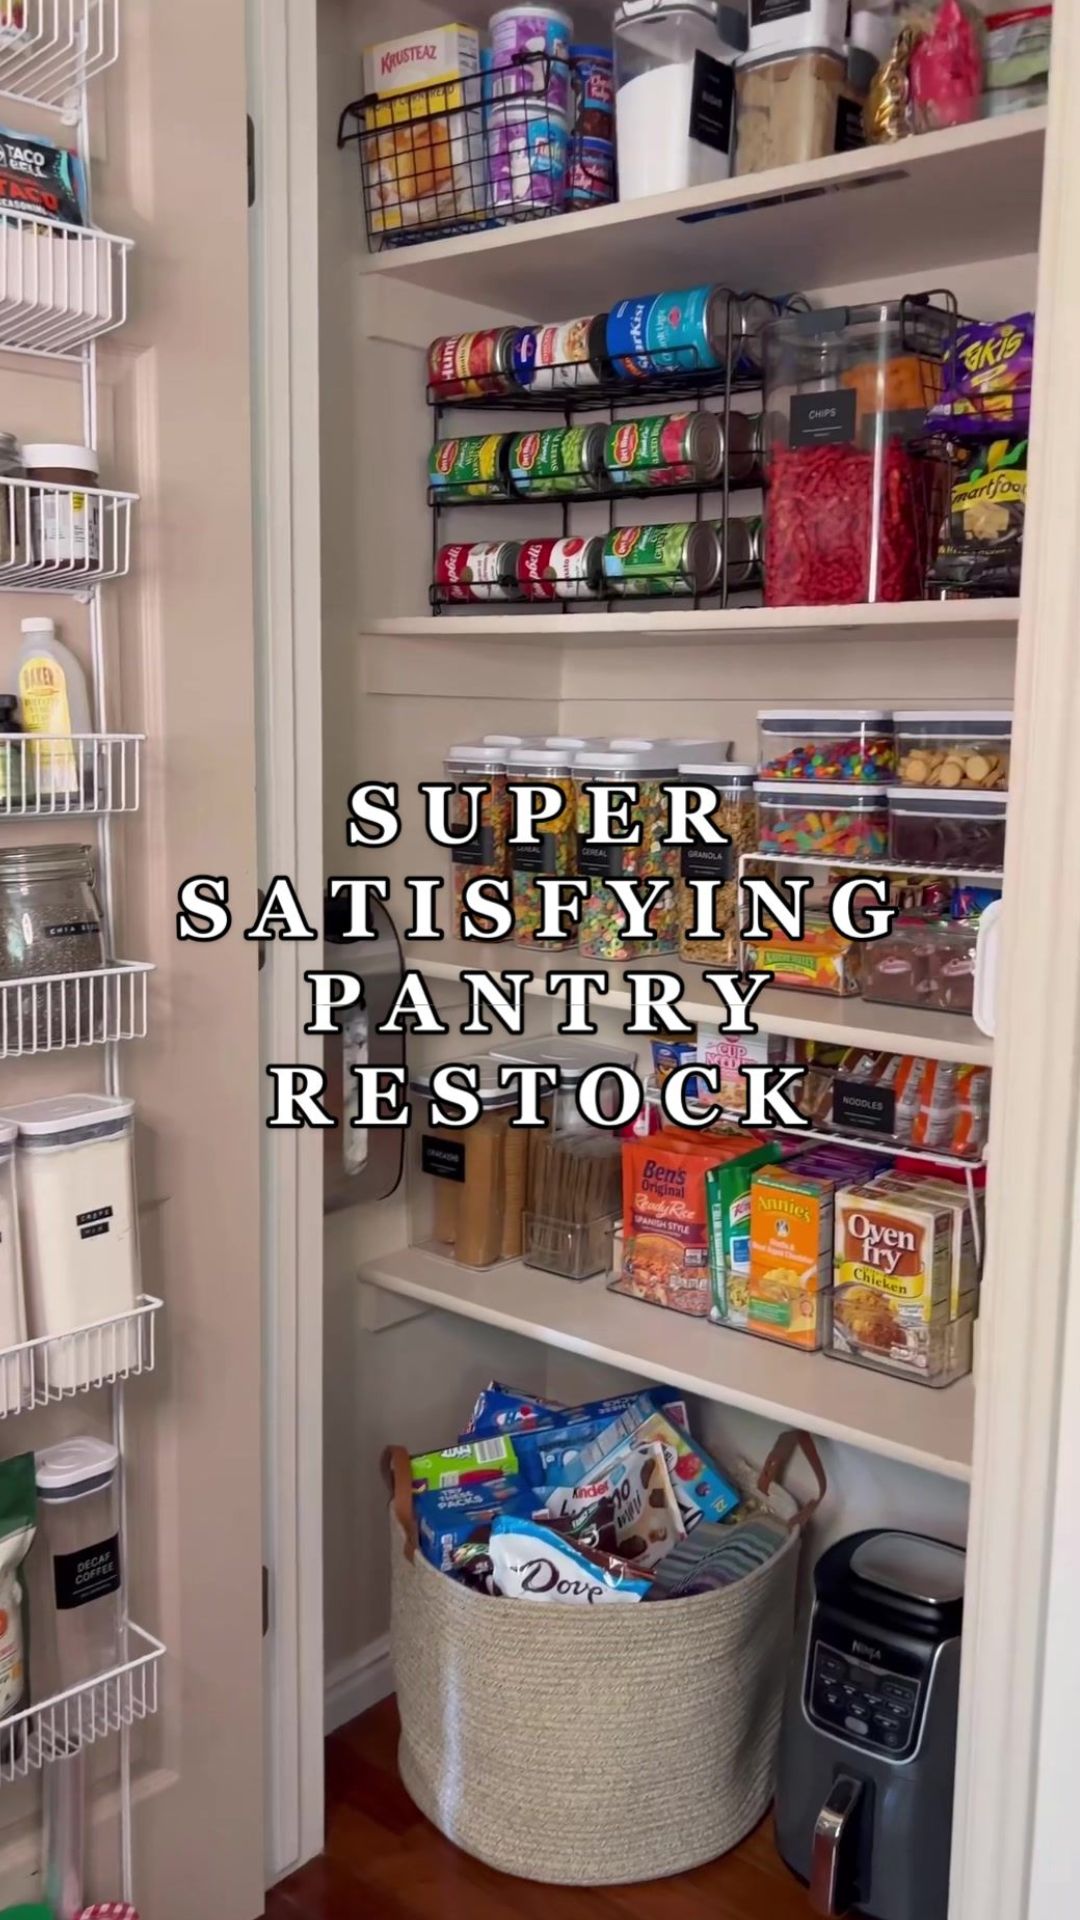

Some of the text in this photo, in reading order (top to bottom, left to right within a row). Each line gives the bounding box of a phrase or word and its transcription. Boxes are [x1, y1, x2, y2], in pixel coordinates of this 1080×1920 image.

[380, 44, 437, 75] KRUSTEAZ
[4, 143, 45, 167] TACO
[9, 159, 49, 178] BELL
[808, 407, 838, 420] CHIPS
[582, 847, 608, 858] CEREAL
[688, 850, 722, 860] GRANOLA
[718, 1043, 746, 1058] CUP
[843, 1096, 884, 1111] NOODLES
[643, 1160, 687, 1185] Ben's
[641, 1179, 686, 1199] Original
[635, 1193, 696, 1219] Ready Rice
[757, 1196, 812, 1222] Annie's
[634, 1214, 690, 1235] SPANISH STYLE
[848, 1214, 915, 1251] Oven
[862, 1235, 902, 1275] fry
[853, 1267, 908, 1295] Chicken
[572, 1479, 609, 1498] Kinder
[75, 1562, 115, 1585] COFFEE
[77, 1552, 112, 1573] DECAF
[510, 1558, 604, 1604] Dove
